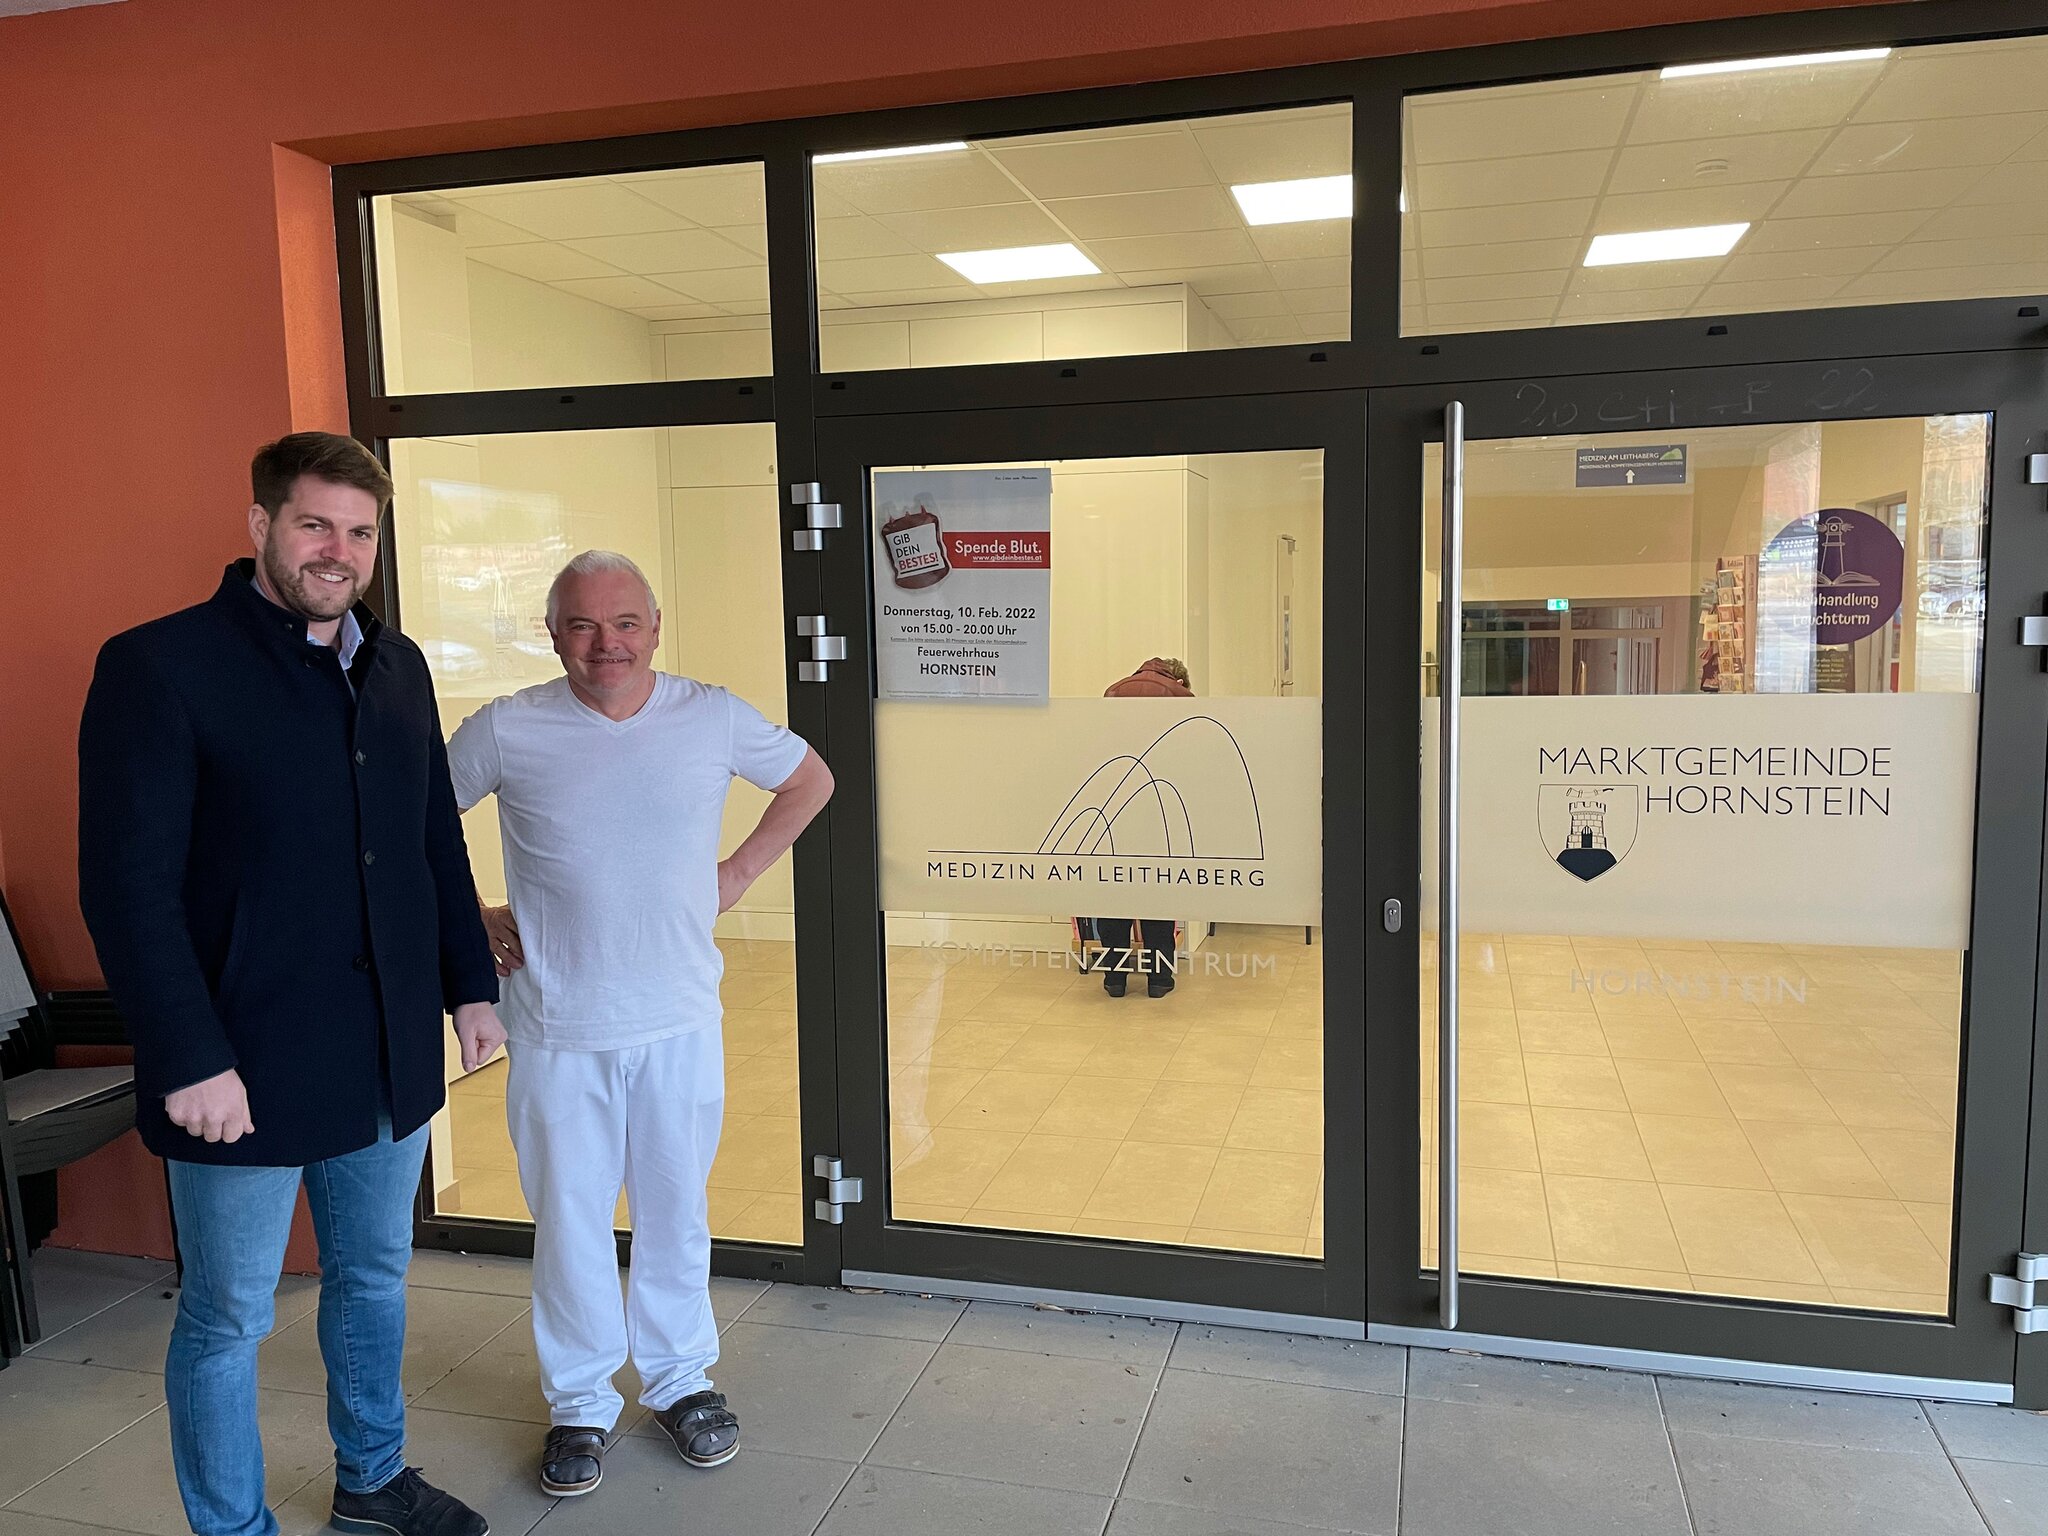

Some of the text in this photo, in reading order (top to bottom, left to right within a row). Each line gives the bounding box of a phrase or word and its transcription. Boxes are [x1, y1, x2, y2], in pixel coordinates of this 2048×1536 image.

[1620, 452, 1660, 460] LEITHABERG
[893, 533, 911, 546] GIB
[955, 539, 1042, 556] Spende Blut.
[895, 543, 921, 559] DEIN
[972, 554, 1042, 562] www.gibdeinbestes.at
[899, 552, 939, 571] BESTES!
[1786, 592, 1879, 609] uchhandlung
[883, 604, 1036, 620] Donnerstag, 10. Feb. 2022
[900, 624, 920, 633] von
[922, 623, 953, 634] 15.00
[963, 624, 994, 635] 20.00
[997, 624, 1017, 636] Uhr
[917, 646, 1000, 658] Feuerwehrhaus
[920, 663, 996, 676] HORNSTEIN
[1539, 747, 1892, 777] MARKTGEMEINDE
[1646, 785, 1890, 816] HORNSTEIN
[927, 862, 1266, 887] MEDIZIN AM LEITHABERG
[920, 940, 1277, 979] KOMPETENZZENTRUM
[1570, 968, 1808, 1003] HORNSTEIN
